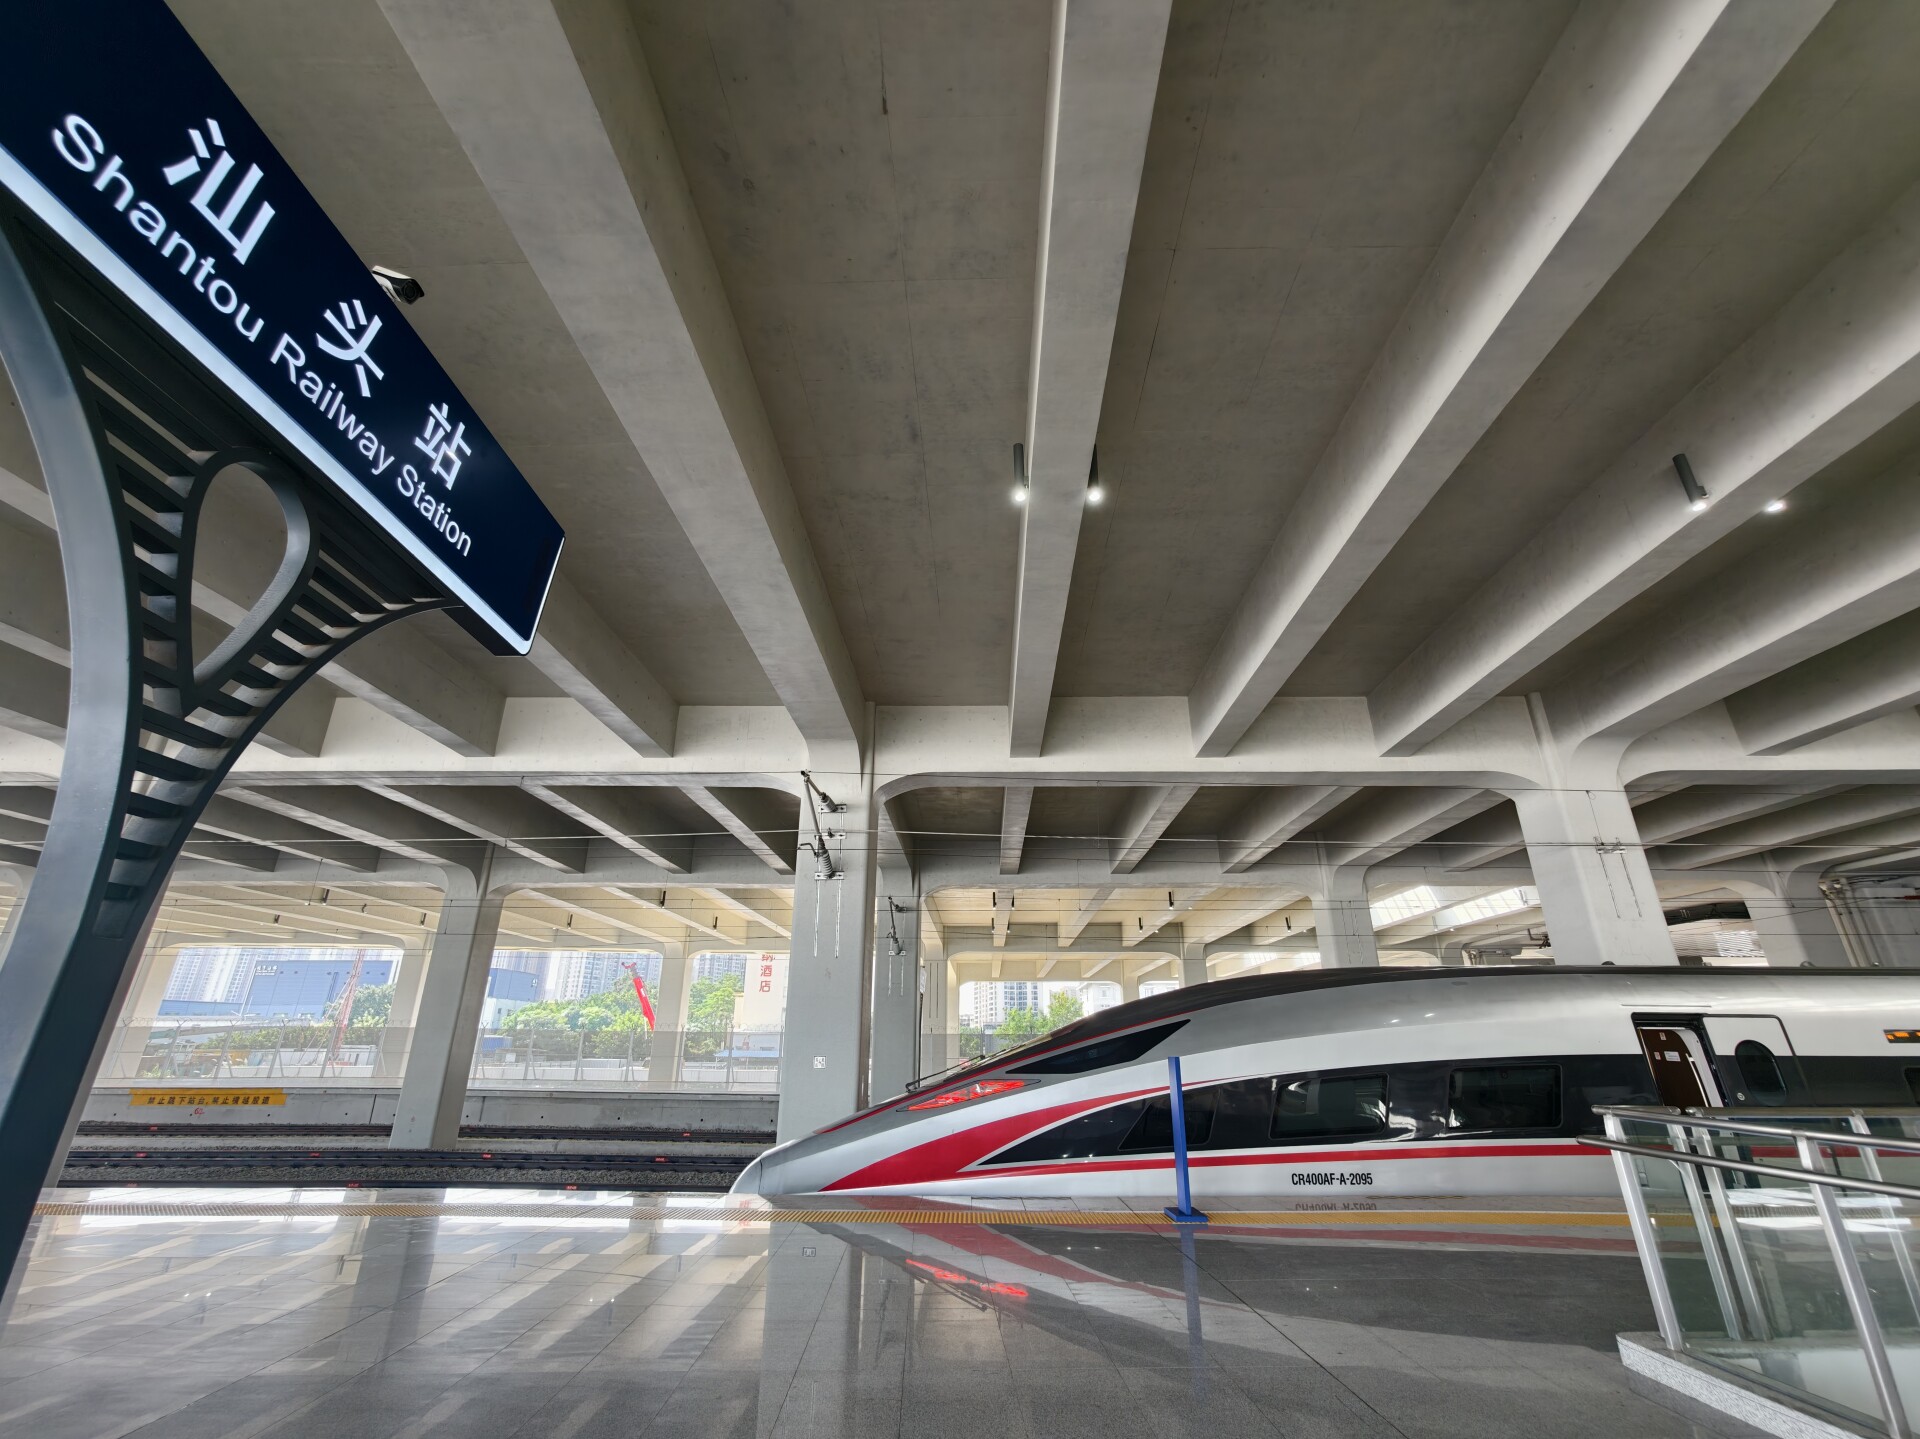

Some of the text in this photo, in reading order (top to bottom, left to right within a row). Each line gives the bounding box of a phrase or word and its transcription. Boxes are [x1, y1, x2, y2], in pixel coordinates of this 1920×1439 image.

[52, 114, 472, 557] Shantou Railway Station
[163, 118, 471, 490] 汕头站
[1291, 1173, 1373, 1186] CR400AF-A-2095
